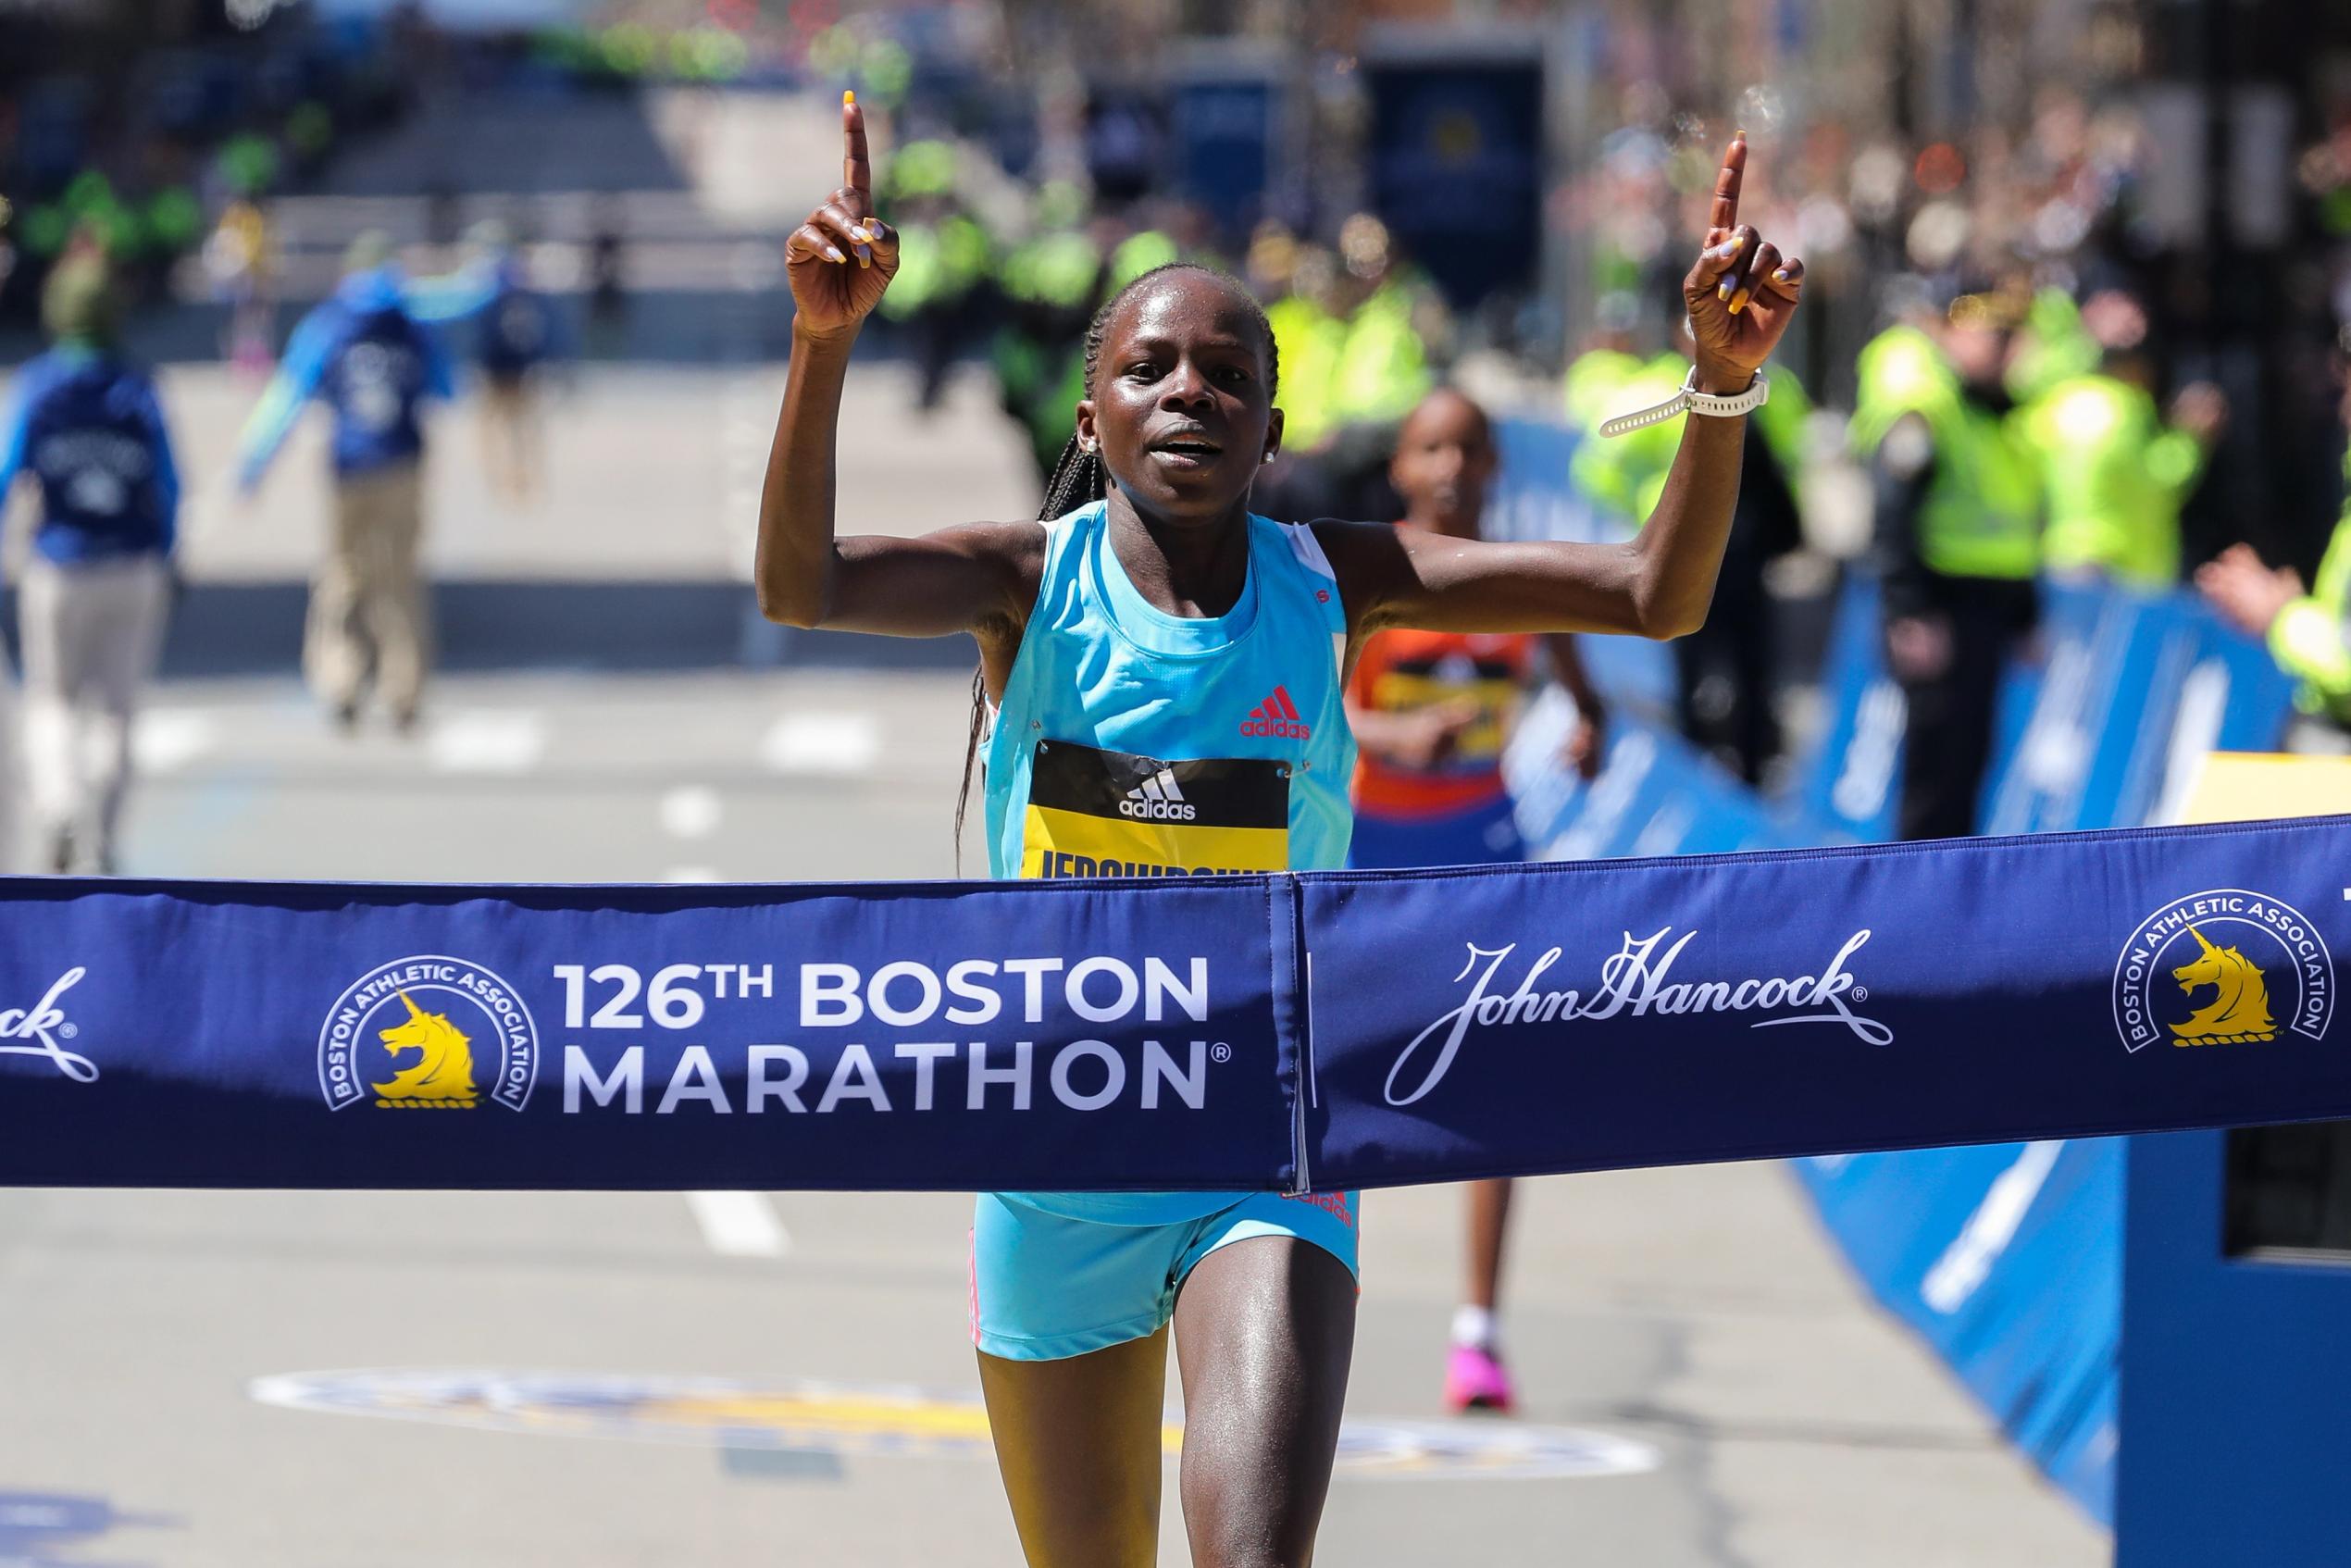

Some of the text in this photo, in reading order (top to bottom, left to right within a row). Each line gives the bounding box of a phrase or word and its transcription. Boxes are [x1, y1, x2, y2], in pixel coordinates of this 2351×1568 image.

[1240, 717, 1310, 740] adidas
[1119, 799, 1196, 821] adidas
[553, 955, 1209, 1030] 126TH BOSTON
[2123, 898, 2325, 1041] BOSTON ATHLETIC ASSOCIATION
[328, 964, 529, 1101] BOSTON ATHLETIC ASSOCIATION
[1384, 940, 1581, 1106] John
[1279, 1191, 1352, 1228] didas
